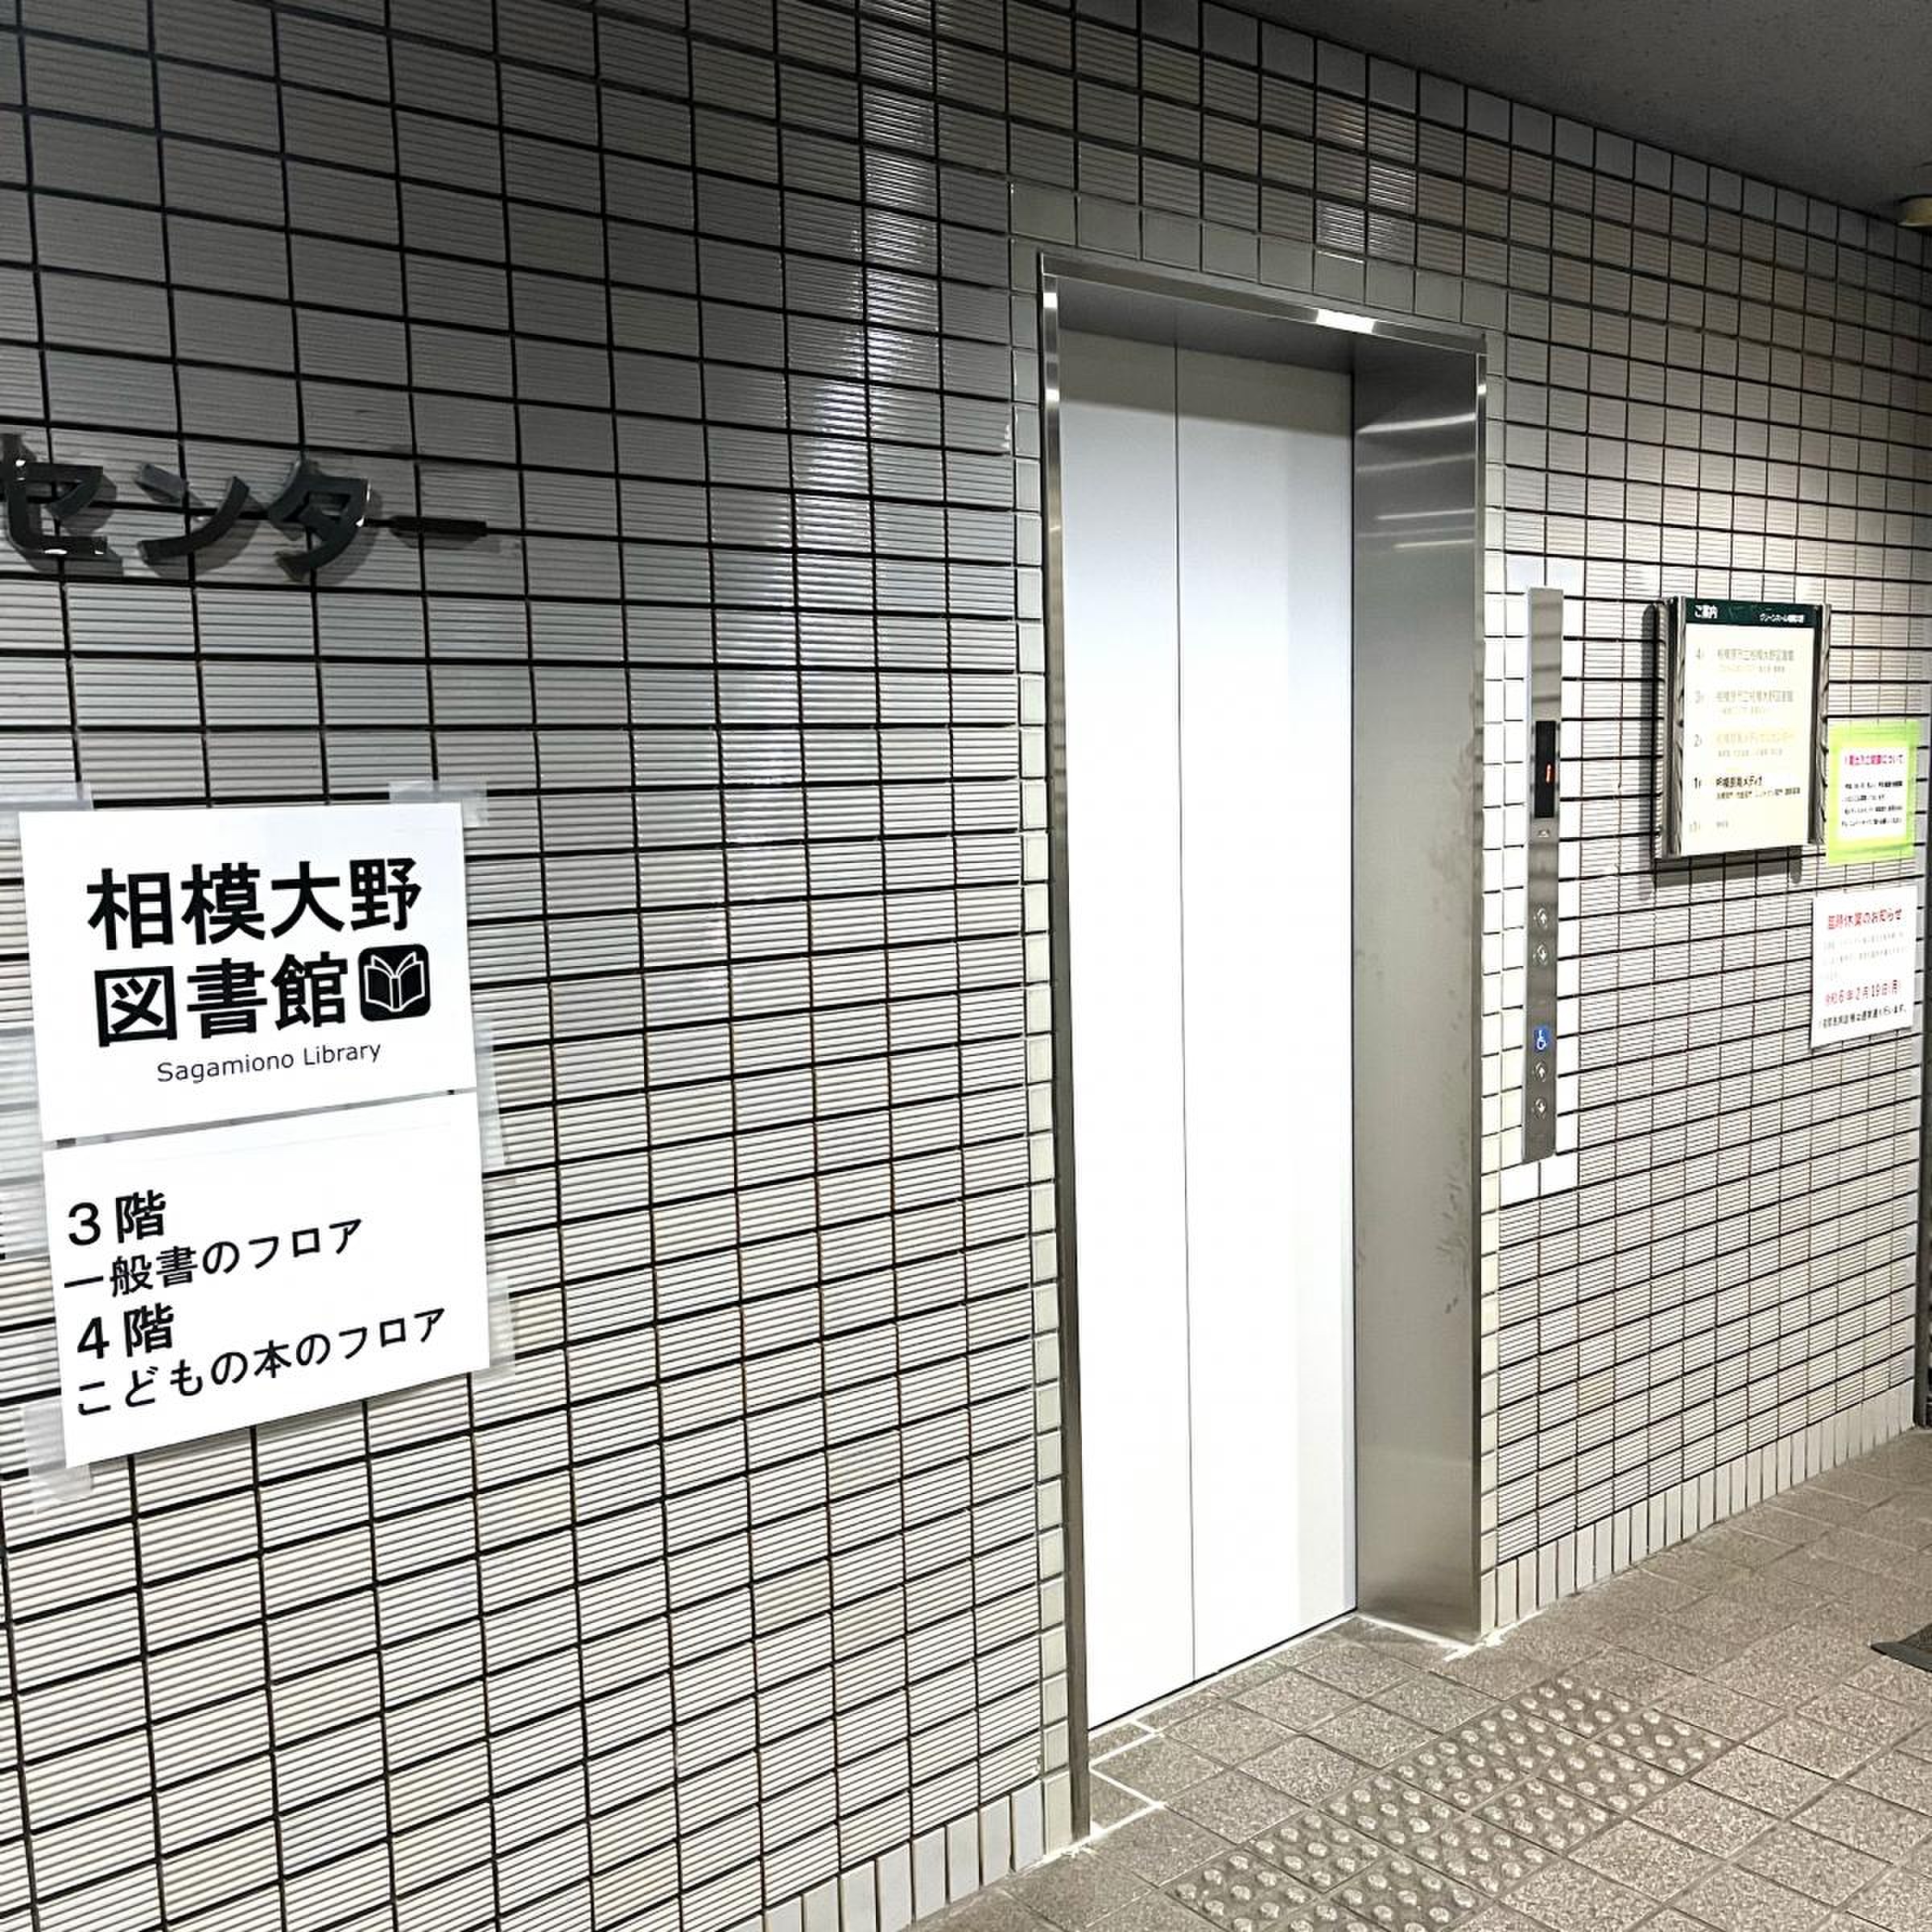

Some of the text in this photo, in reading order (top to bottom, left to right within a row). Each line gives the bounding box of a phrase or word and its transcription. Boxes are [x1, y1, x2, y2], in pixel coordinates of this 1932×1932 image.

[0, 433, 487, 583] センター
[86, 857, 423, 951] 相模大野
[93, 951, 349, 1048] 図書館
[157, 1040, 382, 1084] Sagamiono Library
[64, 1218, 362, 1298] 一般書のフロア
[68, 1189, 167, 1247] 3階
[76, 1302, 175, 1360] 4階
[78, 1307, 446, 1417] こどもの本のフロア
